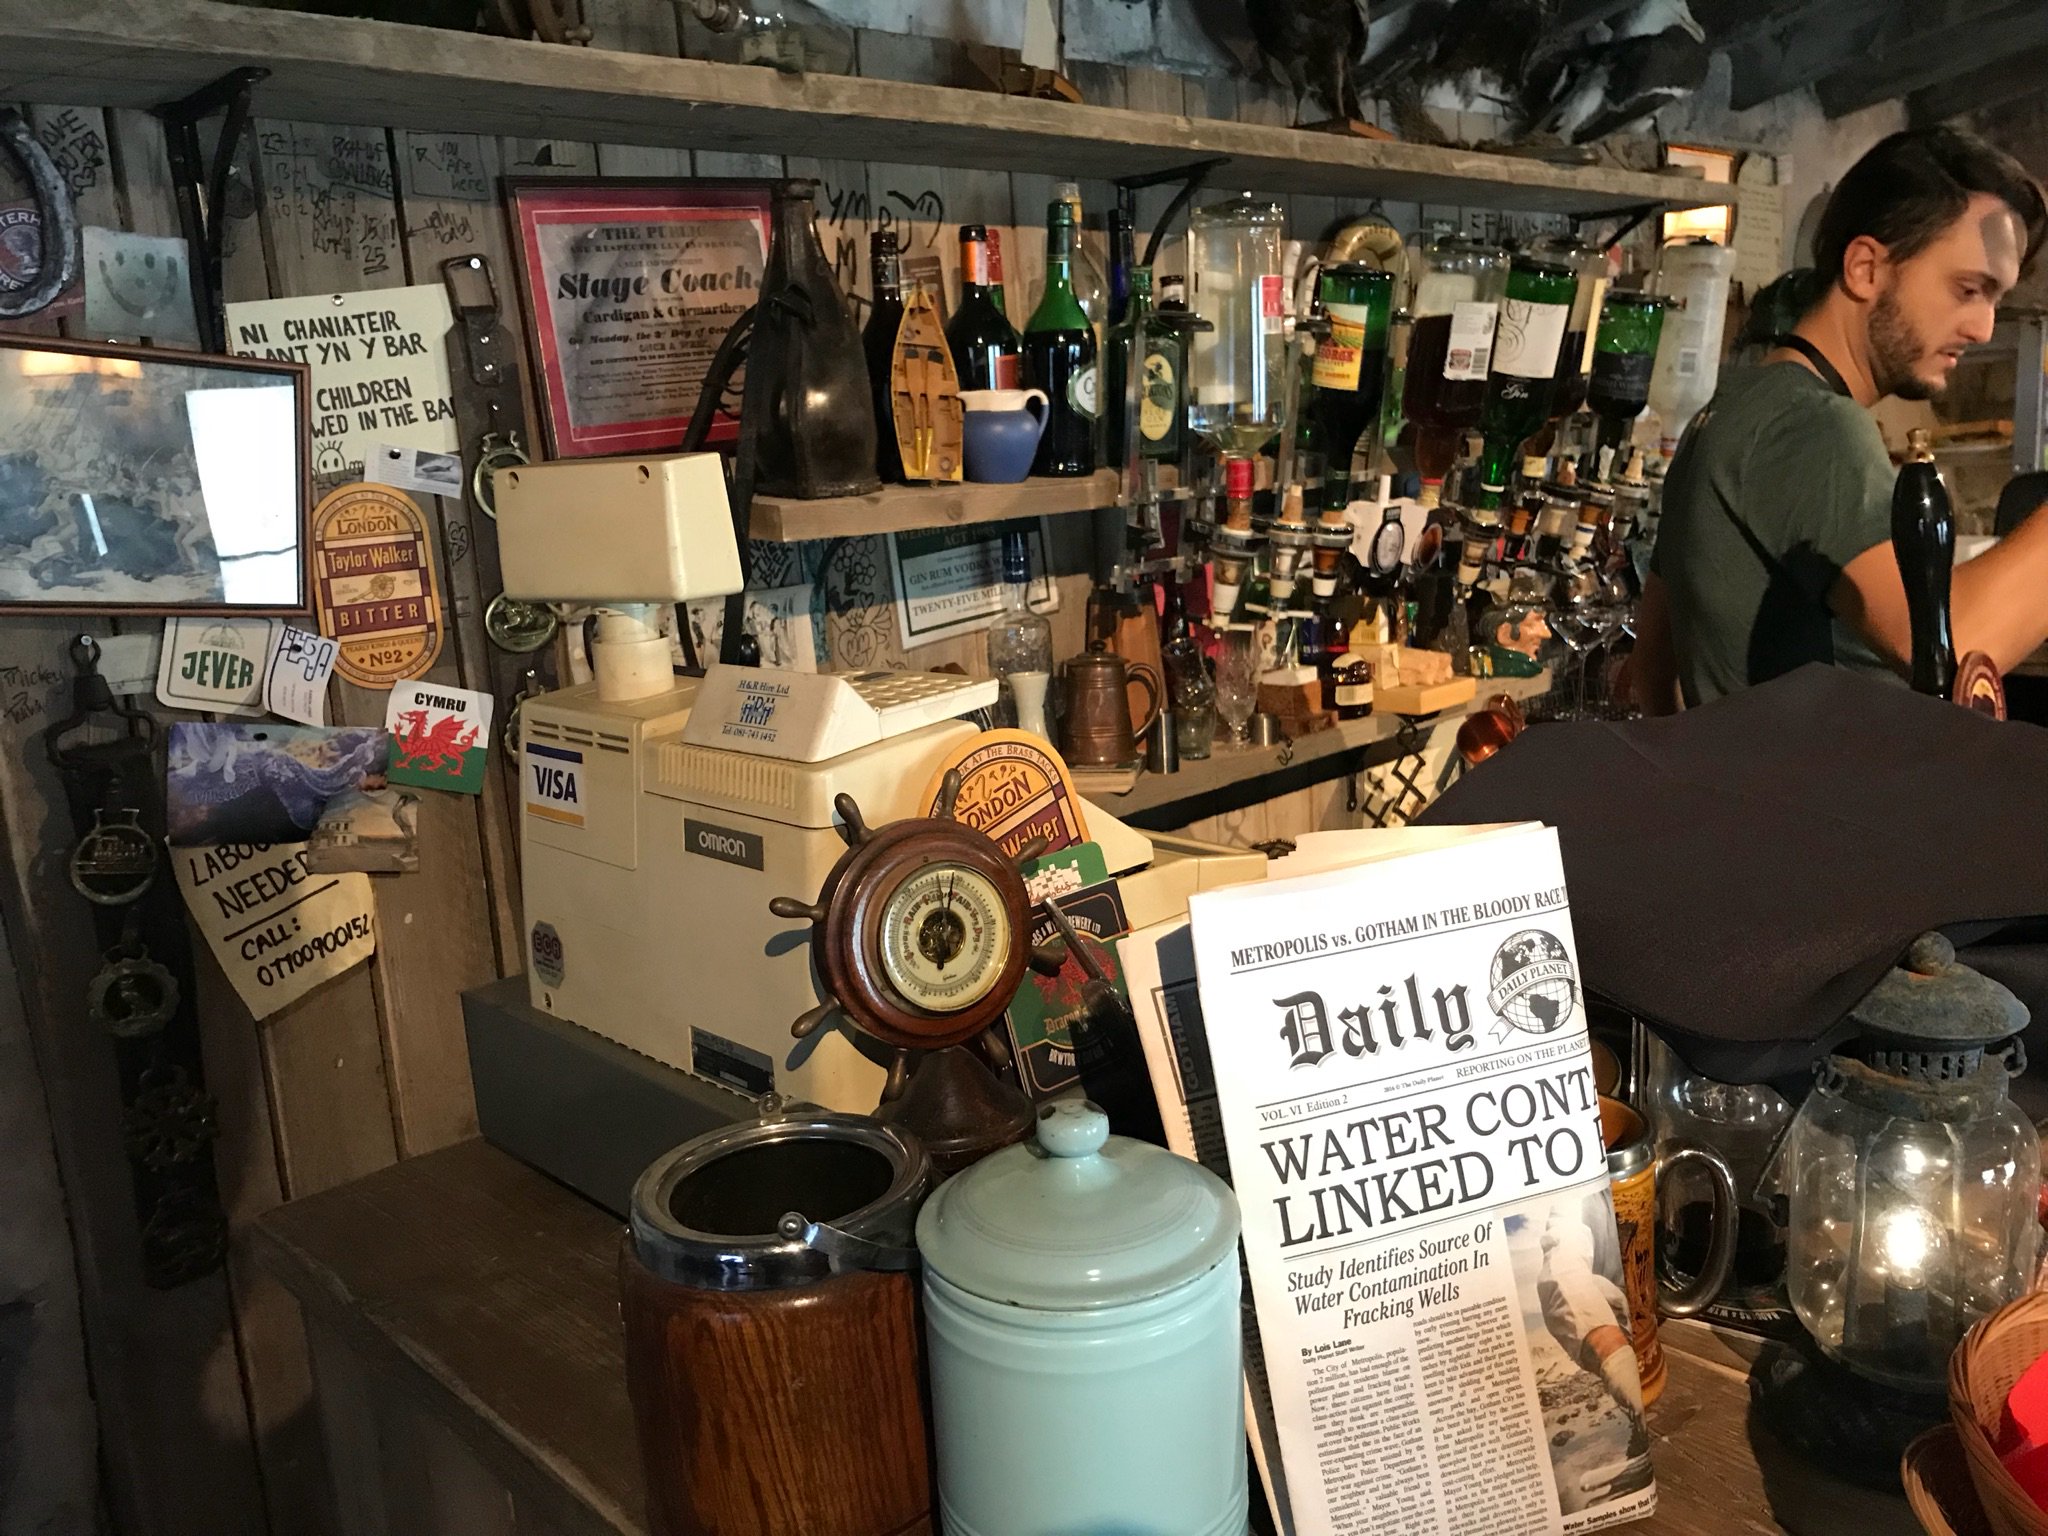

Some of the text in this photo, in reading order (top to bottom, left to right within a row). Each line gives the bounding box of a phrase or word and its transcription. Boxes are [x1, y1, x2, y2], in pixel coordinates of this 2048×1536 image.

[602, 226, 641, 241] THE
[557, 270, 650, 303] Stage
[239, 310, 402, 345] NI CHANIATEIR
[582, 303, 650, 325] Cardigan
[652, 306, 665, 319] &
[667, 302, 747, 321] Carmarthen
[316, 342, 352, 365] YN
[359, 337, 376, 359] Y
[384, 332, 428, 358] BAR
[316, 376, 413, 412] CHILDREN
[1501, 384, 1529, 400] Gin
[358, 410, 378, 431] IN
[380, 403, 418, 428] THE
[336, 515, 400, 536] LONDON
[944, 531, 968, 547] ACT
[328, 547, 414, 574] Taylor Walker
[909, 575, 928, 586] GIN
[929, 569, 953, 582] RUM
[339, 602, 419, 628] BITTER
[912, 591, 979, 617] TWENTY-FIVE
[181, 650, 254, 690] JEVER
[414, 692, 467, 713] CYMRU
[760, 682, 775, 692] Hire
[776, 684, 790, 695] Ltd
[972, 744, 1058, 781] AT THE BRASS TACKS
[532, 764, 578, 804] VISA
[965, 770, 1032, 830] ONDON
[698, 830, 746, 859] OMRON
[239, 917, 302, 962] CALL:
[1230, 887, 1561, 968] METROPOLIS vs. GOTHAM IN THE BLOODY RACE
[1498, 963, 1568, 1000] DAILY PLANET
[1272, 972, 1477, 1072] Daily
[1456, 1037, 1588, 1079] REPORTING ON THE PLANET
[1412, 1079, 1427, 1087] Daily
[1427, 1075, 1444, 1084] Planet
[1288, 1104, 1303, 1118] VI
[1306, 1096, 1341, 1113] Edition
[1342, 1094, 1348, 1105] 2
[1261, 1103, 1454, 1185] WATER
[1466, 1065, 1600, 1137] CONT
[1272, 1150, 1494, 1248] LINKED
[1508, 1127, 1583, 1187] TO
[1287, 1220, 1493, 1293] Study Identifies Source Of
[1295, 1249, 1489, 1316] Water Contamination In
[1343, 1282, 1460, 1330] Fracking Wells
[1301, 1338, 1352, 1357] By Lois Lane
[1302, 1357, 1317, 1365] Daily
[1317, 1352, 1334, 1361] Planet
[1335, 1348, 1348, 1356] Staff
[1313, 1368, 1324, 1376] The
[1326, 1364, 1339, 1373] City
[1340, 1361, 1347, 1369] of
[1360, 1365, 1370, 1373] had
[1371, 1360, 1392, 1371] enough
[1393, 1357, 1399, 1365] of
[1400, 1355, 1409, 1363] the
[1308, 1385, 1335, 1397] pollution
[1563, 1520, 1584, 1531] Water
[1587, 1511, 1617, 1525] Samples
[1619, 1504, 1637, 1515] show
[1638, 1497, 1650, 1508] that
